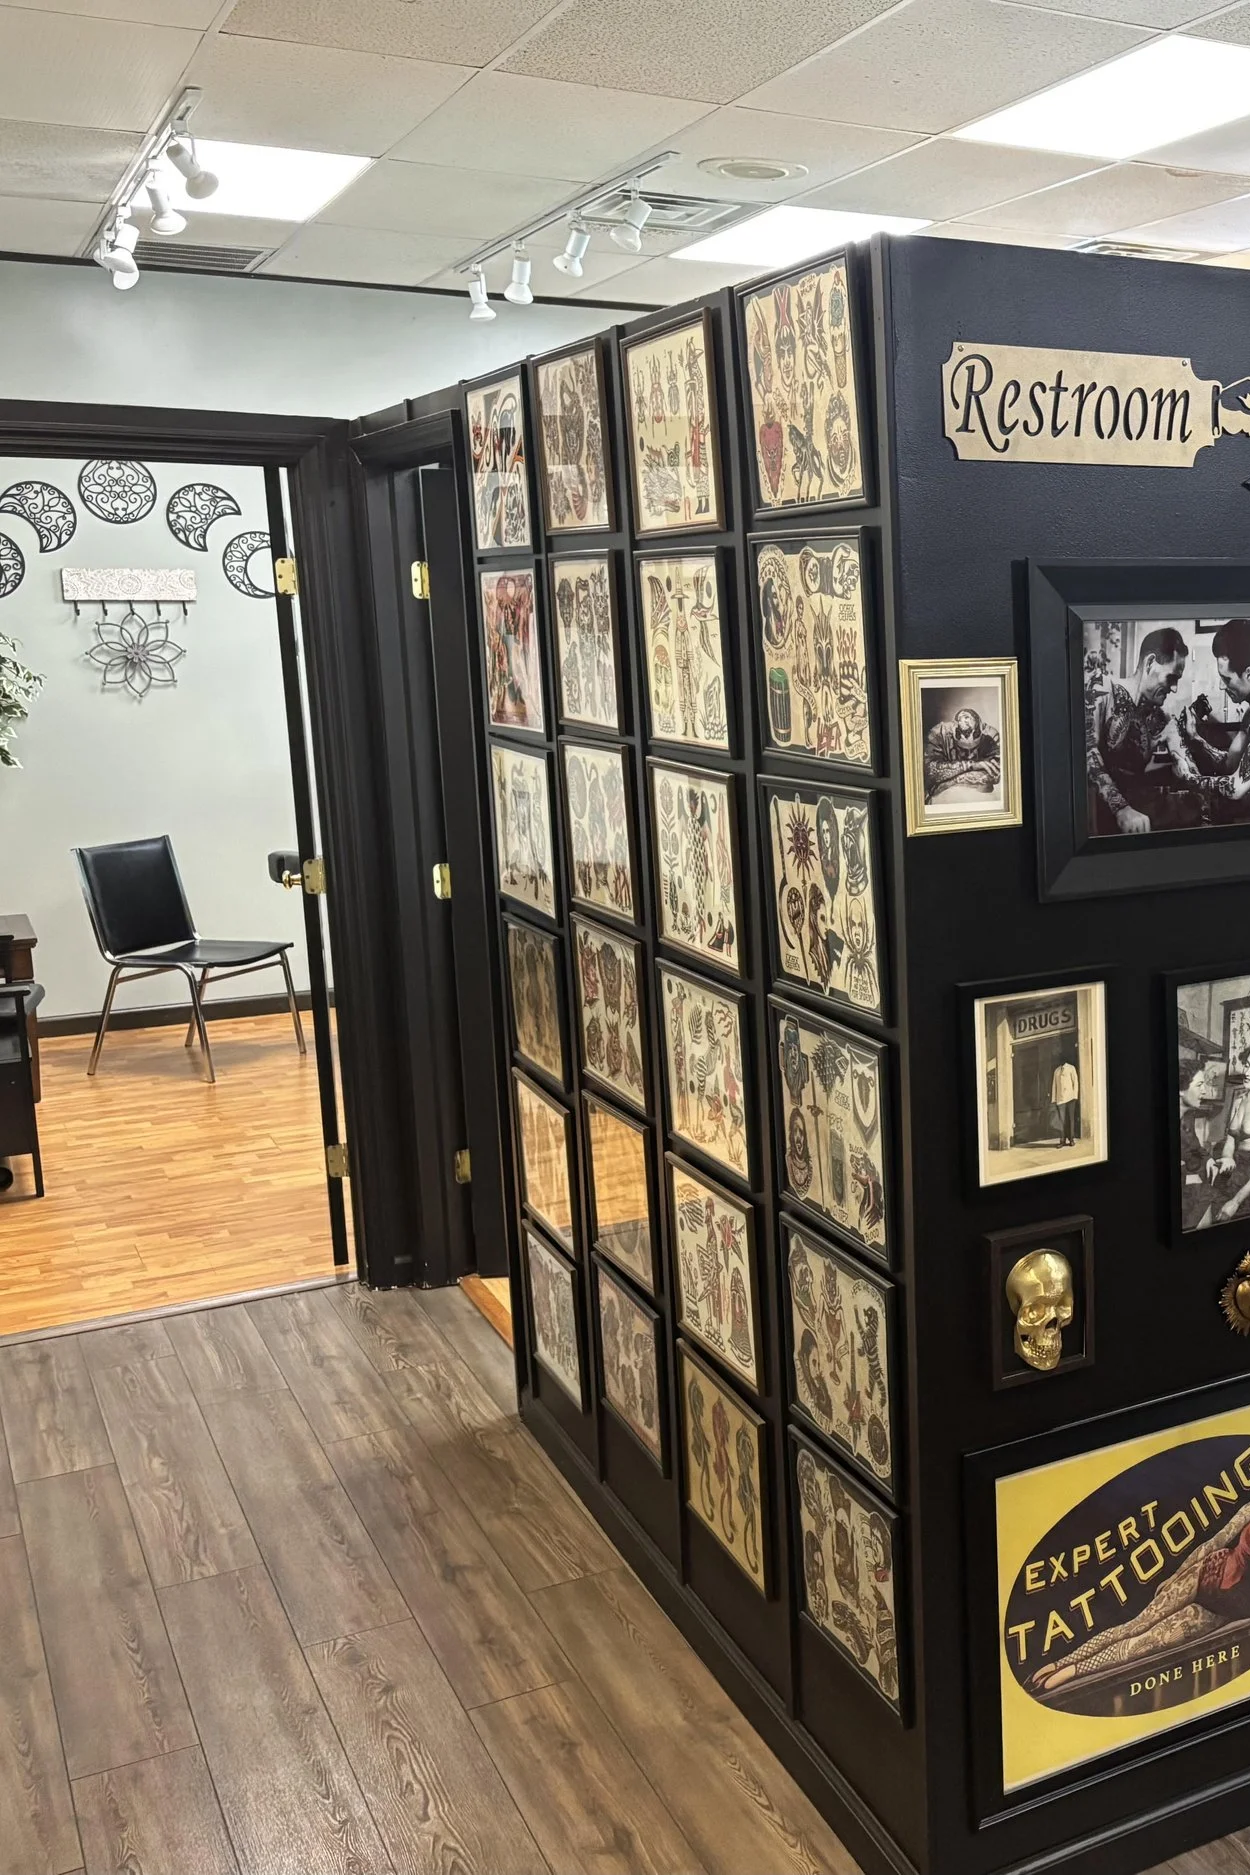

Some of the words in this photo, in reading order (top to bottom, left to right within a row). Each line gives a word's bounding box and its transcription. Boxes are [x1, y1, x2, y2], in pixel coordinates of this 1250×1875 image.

[950, 353, 1193, 453] Restroom
[1017, 1008, 1072, 1034] DRUGS
[1025, 1500, 1159, 1595] EXPERT
[1129, 1666, 1184, 1697] DONE
[1191, 1645, 1241, 1674] HERE
